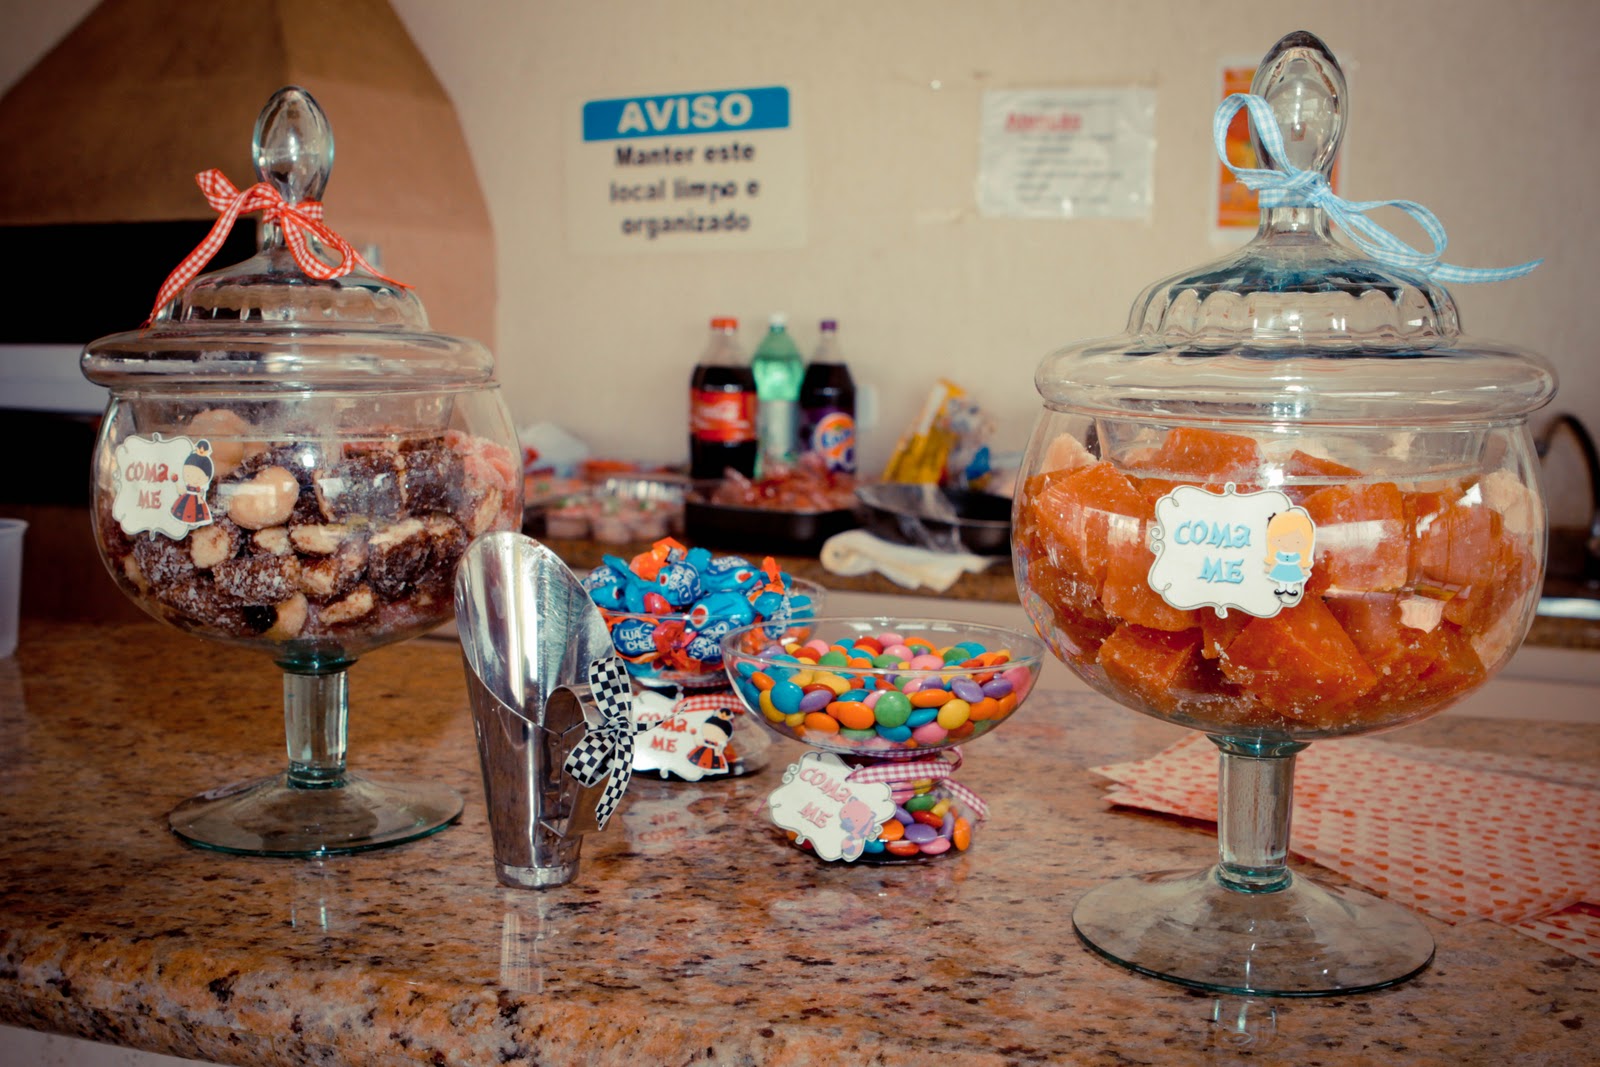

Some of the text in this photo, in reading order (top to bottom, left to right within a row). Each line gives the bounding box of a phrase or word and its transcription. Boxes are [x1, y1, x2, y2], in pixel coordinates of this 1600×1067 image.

[617, 92, 753, 133] AVISO
[615, 142, 754, 166] Manter este
[610, 179, 759, 204] local limpo e
[621, 211, 751, 239] organizado
[138, 490, 162, 509] ME
[1197, 556, 1245, 584] ME
[620, 628, 641, 641] LUA
[650, 735, 679, 753] ME
[797, 801, 834, 829] ME
